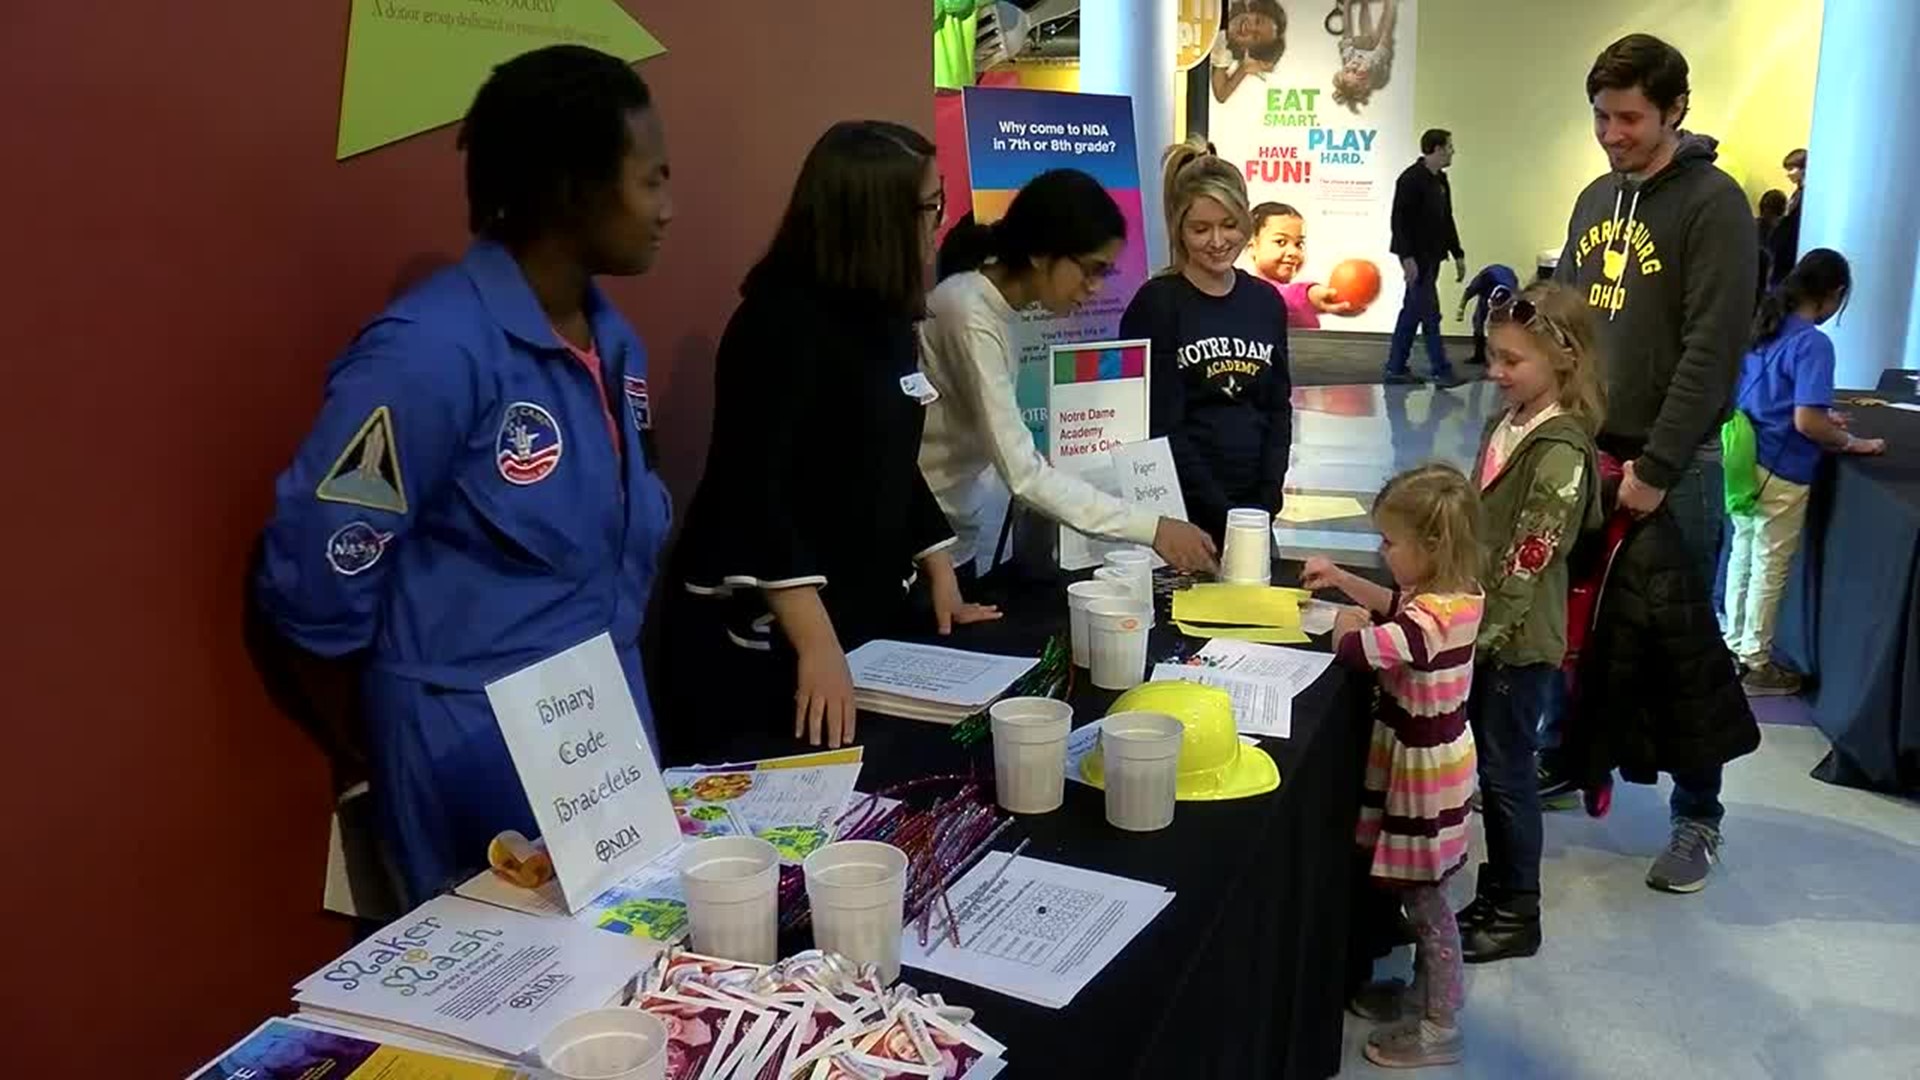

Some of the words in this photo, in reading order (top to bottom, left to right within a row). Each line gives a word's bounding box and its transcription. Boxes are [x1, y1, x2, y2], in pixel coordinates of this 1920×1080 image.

[1267, 88, 1321, 112] EAT
[999, 121, 1026, 136] Why
[1029, 123, 1065, 135] come
[1068, 123, 1081, 136] to
[1082, 124, 1109, 136] NDA
[1263, 114, 1321, 127] SMART.
[993, 138, 1006, 150] in
[1008, 138, 1031, 150] 7th
[1033, 141, 1048, 151] or
[1051, 139, 1072, 152] 8th
[1074, 141, 1117, 154] grade?
[1308, 128, 1377, 151] PLAY
[1258, 146, 1298, 159] HAVE
[1320, 152, 1365, 165] HARD.
[1245, 160, 1311, 184] FUN!
[1177, 337, 1232, 369] NOTRE
[1233, 338, 1274, 366] DAM
[1206, 359, 1260, 379] ACADEMY
[1060, 411, 1086, 423] Notre
[1088, 408, 1115, 420] Dame
[1059, 427, 1104, 440] Academy
[1060, 443, 1097, 457] Maker's
[1132, 460, 1157, 477] Paper
[535, 683, 596, 726] Binary
[557, 729, 608, 766] Code
[553, 765, 642, 825] Bracelets
[609, 824, 641, 854] NDA
[323, 915, 442, 991] Maker
[381, 928, 504, 997] Mash
[522, 972, 567, 1001] NDA
